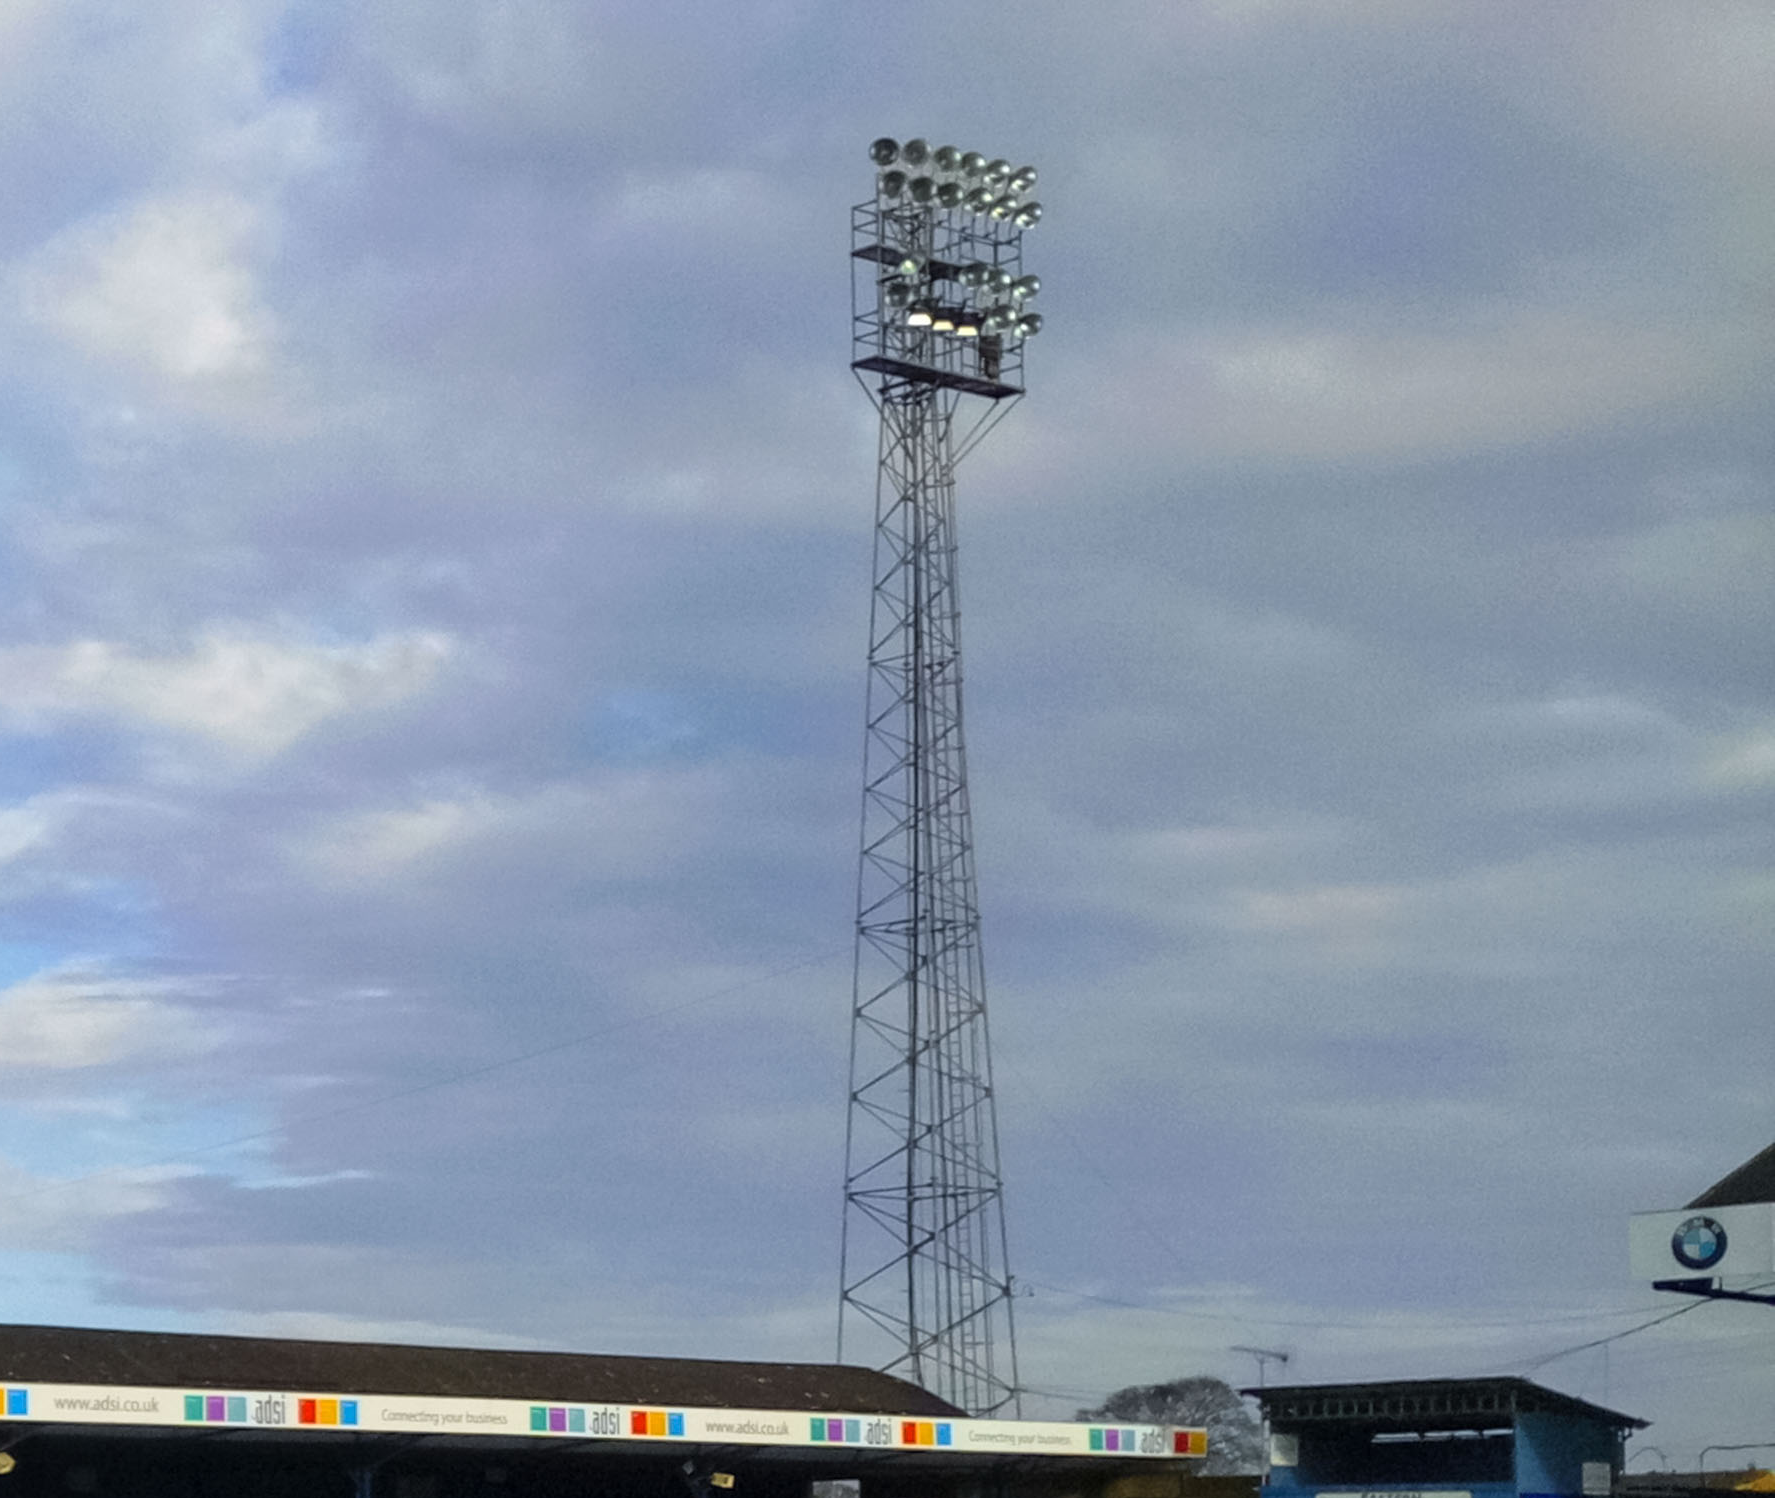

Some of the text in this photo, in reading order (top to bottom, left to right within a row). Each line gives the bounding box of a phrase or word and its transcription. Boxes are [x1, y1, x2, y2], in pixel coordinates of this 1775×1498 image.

[53, 1396, 159, 1413] www.adsi.co.uk
[254, 1395, 285, 1424] adsi
[381, 1409, 508, 1425] Connecting your business
[592, 1407, 620, 1435] adsi
[706, 1419, 789, 1435] www.adsi.co.uk
